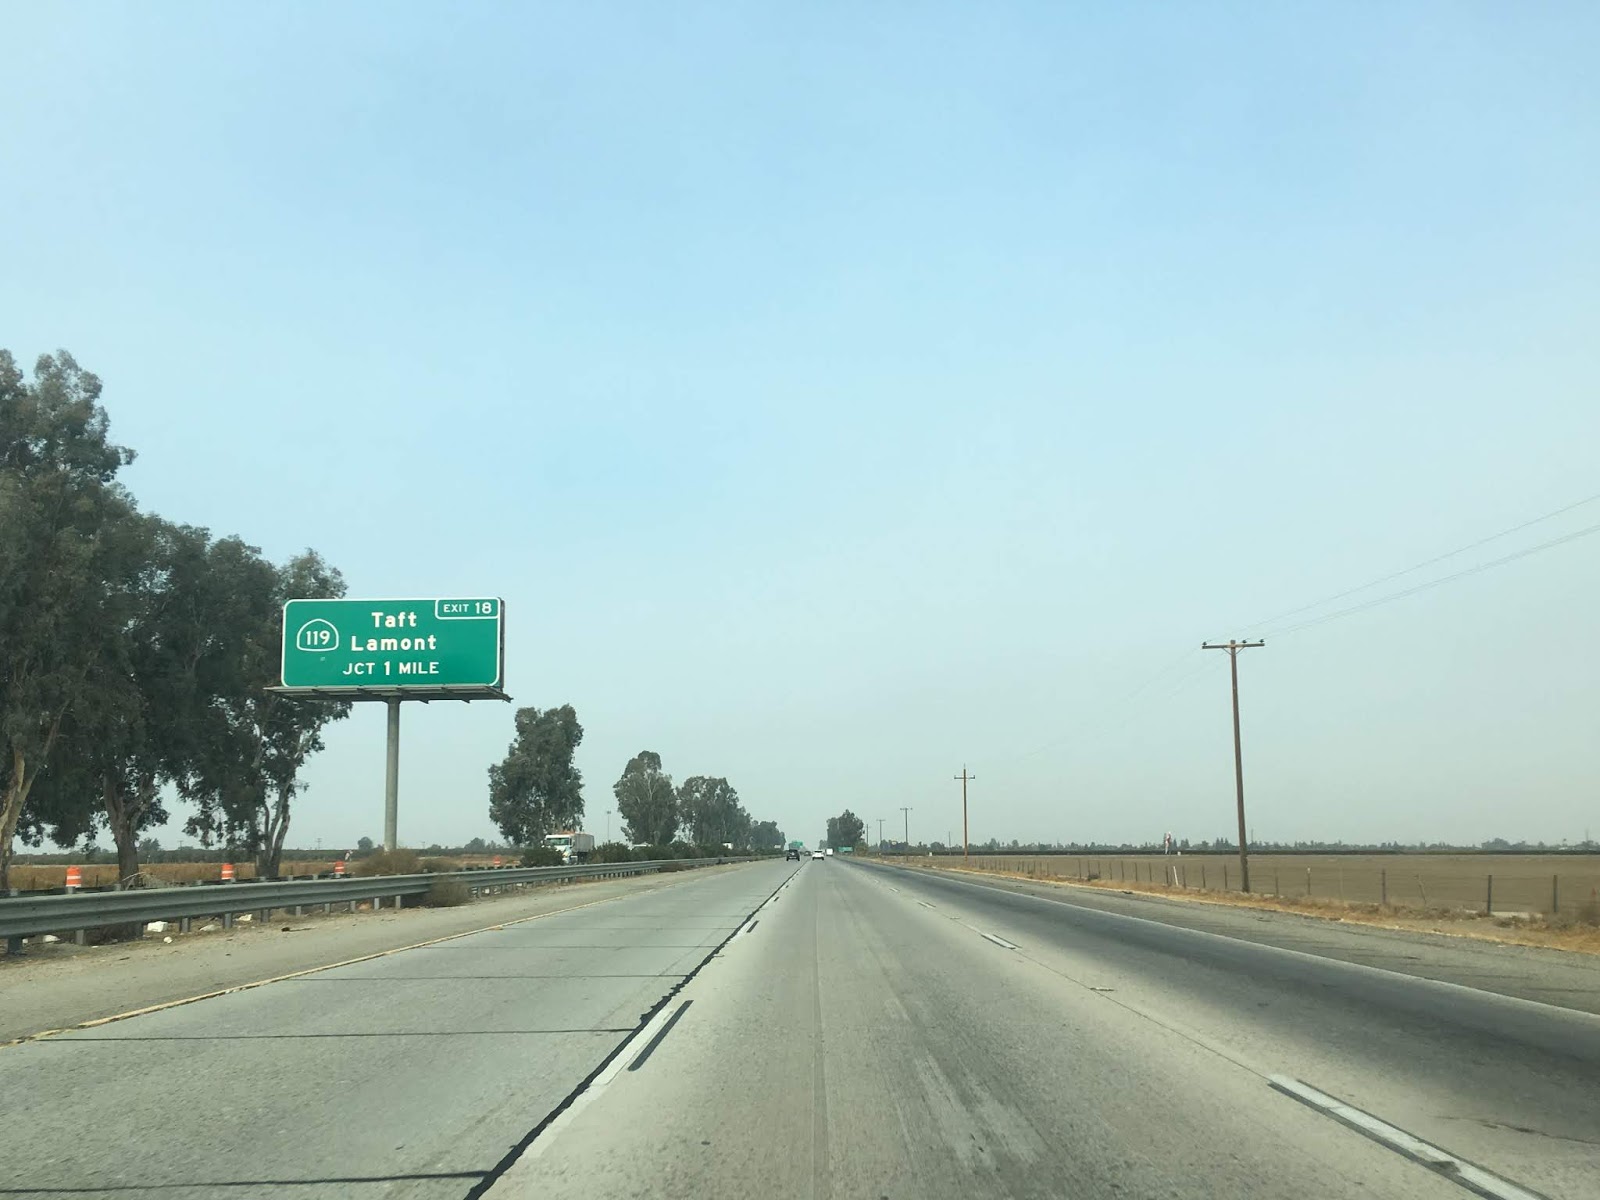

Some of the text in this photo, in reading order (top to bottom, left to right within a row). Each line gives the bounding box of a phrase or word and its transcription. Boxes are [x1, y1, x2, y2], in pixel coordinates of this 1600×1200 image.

[443, 602, 492, 614] EXIT 18
[371, 612, 417, 628] Taft
[305, 630, 330, 645] 119
[351, 634, 437, 651] Lamont
[342, 661, 439, 675] JCT 1 MILE
